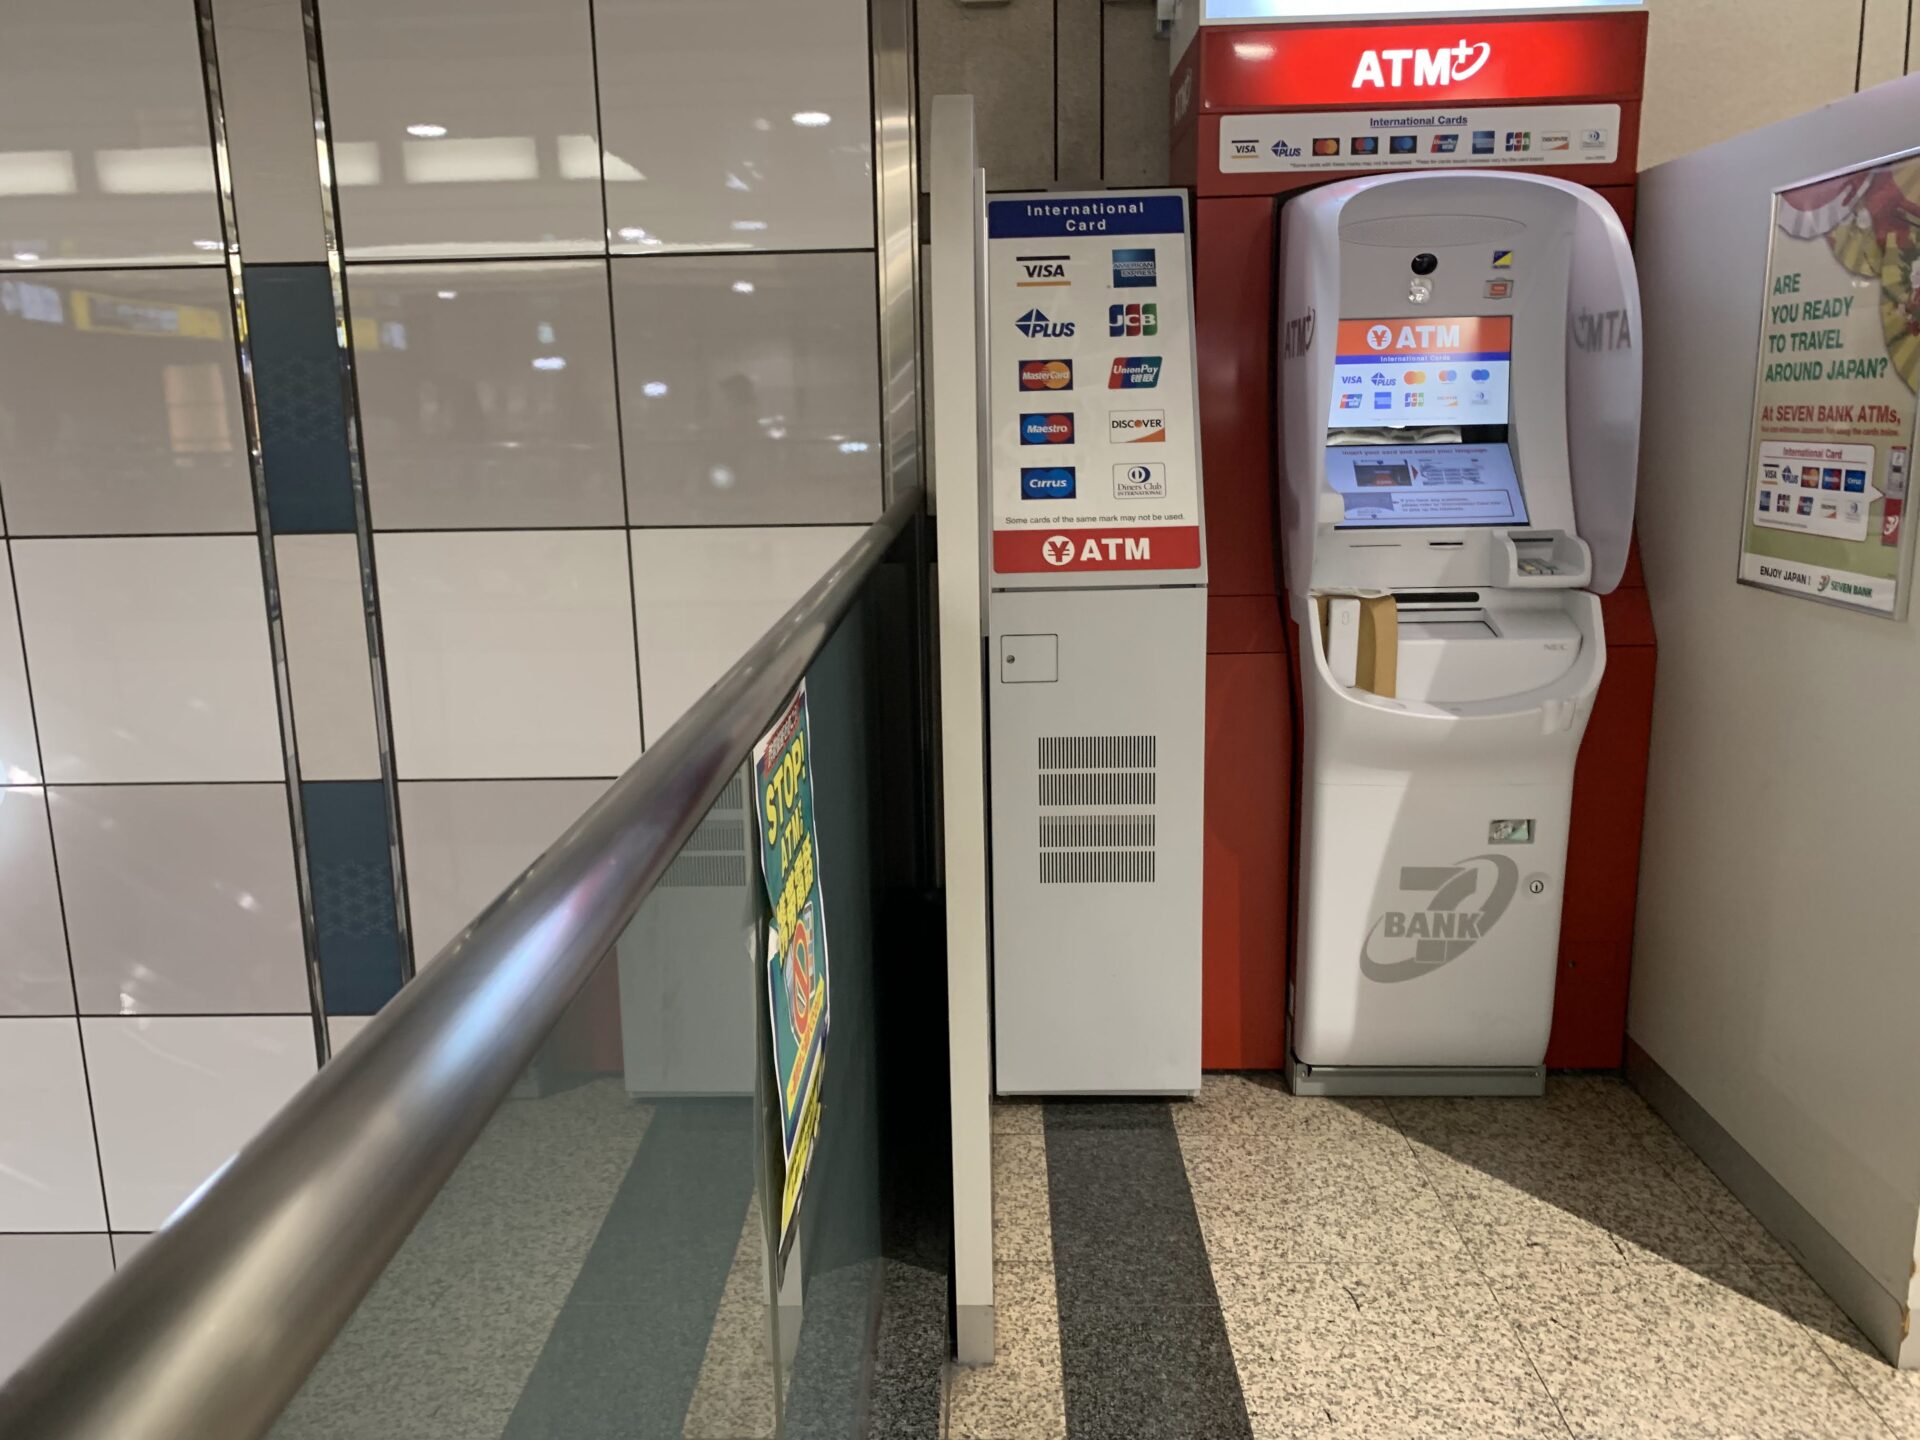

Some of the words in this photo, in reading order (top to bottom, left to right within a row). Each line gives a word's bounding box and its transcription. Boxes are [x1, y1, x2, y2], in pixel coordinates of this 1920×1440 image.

[1351, 48, 1453, 89] ATM
[1370, 116, 1435, 127] International
[1438, 115, 1468, 125] Cards
[1236, 145, 1256, 154] VISA
[1279, 147, 1302, 157] PLUS
[1027, 202, 1144, 216] International
[1066, 219, 1106, 231] Card
[1023, 264, 1065, 278] VISA
[1113, 262, 1154, 270] AMERICAN
[1121, 269, 1156, 277] EXPRESS
[1773, 273, 1801, 295] ARE
[1771, 303, 1799, 324] YOU
[1803, 296, 1854, 321] READY
[1031, 322, 1075, 338] PLUS
[1396, 325, 1460, 349] ATM
[1768, 334, 1785, 353] TO
[1791, 329, 1843, 351] TRAVEL
[1023, 371, 1070, 380] MasterCard
[1113, 364, 1158, 376] UnionPay
[1765, 362, 1822, 382] AROUND
[1827, 357, 1888, 380] JAPAN?
[1341, 376, 1362, 384] VISA
[1376, 378, 1396, 386] PLUS
[1761, 406, 1773, 421] At
[1776, 405, 1814, 422] SEVEN
[1818, 405, 1853, 423] BANK
[1858, 405, 1901, 426] ATMs,
[1027, 424, 1067, 434] Maestro
[1112, 419, 1162, 429] DISCOVER
[1783, 447, 1823, 457] International
[1826, 449, 1843, 459] Card
[1764, 470, 1777, 480] VISA
[1029, 479, 1067, 488] Cirrus
[1118, 483, 1141, 491] Diners
[1143, 482, 1162, 490] Club
[1030, 516, 1050, 524] cards
[1080, 538, 1150, 561] ATM
[1760, 565, 1782, 579] ENJOY
[1831, 581, 1852, 594] SEVEN
[1853, 584, 1873, 598] BANK
[765, 731, 807, 846] STOP!
[1383, 911, 1481, 938] BANK
